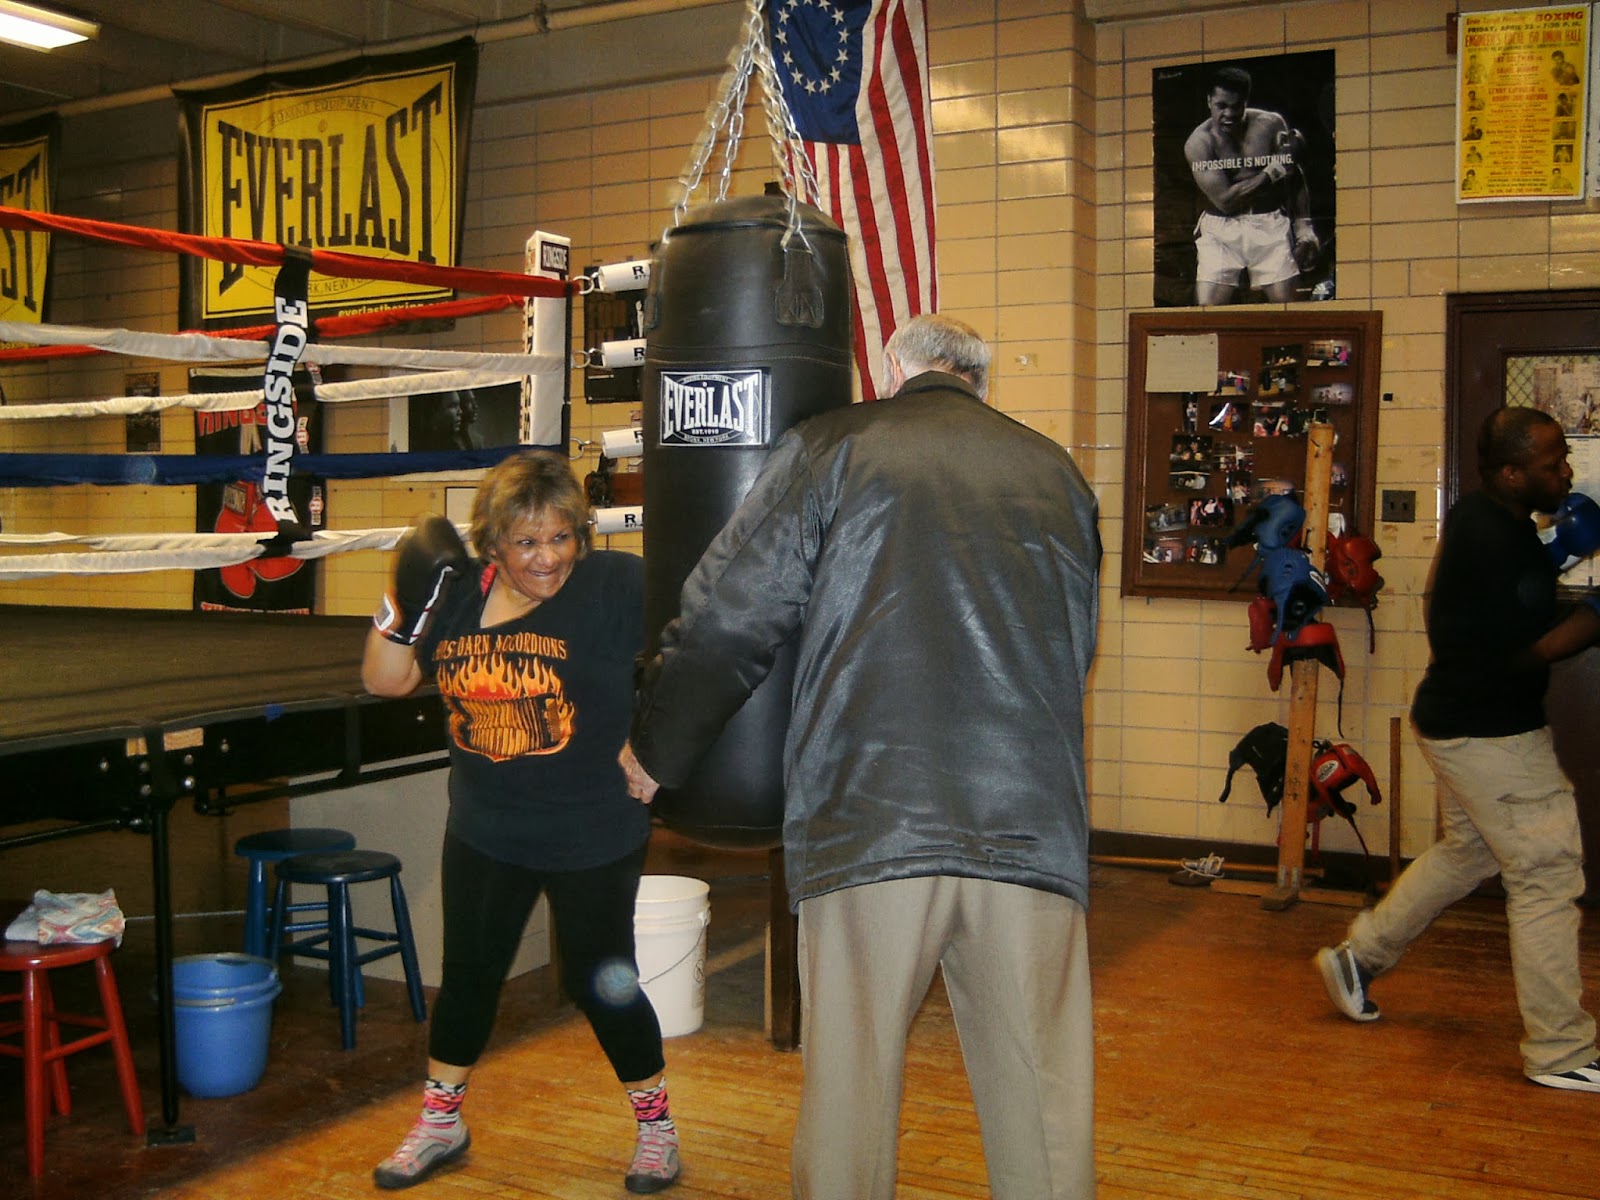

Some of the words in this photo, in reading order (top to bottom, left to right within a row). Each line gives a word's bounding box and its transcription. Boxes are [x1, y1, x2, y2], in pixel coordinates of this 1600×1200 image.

[1536, 11, 1584, 21] BOXING
[1192, 157, 1242, 172] IMPOSSIBLE
[1243, 156, 1253, 168] IS
[1254, 153, 1294, 167] NOTHING.
[218, 81, 443, 296] EVERLAST
[325, 281, 348, 292] NEW
[264, 296, 309, 524] RINGSIDE
[663, 373, 759, 440] EVERLAST
[457, 634, 490, 657] DARN
[494, 631, 567, 660] ACCORDIONS
